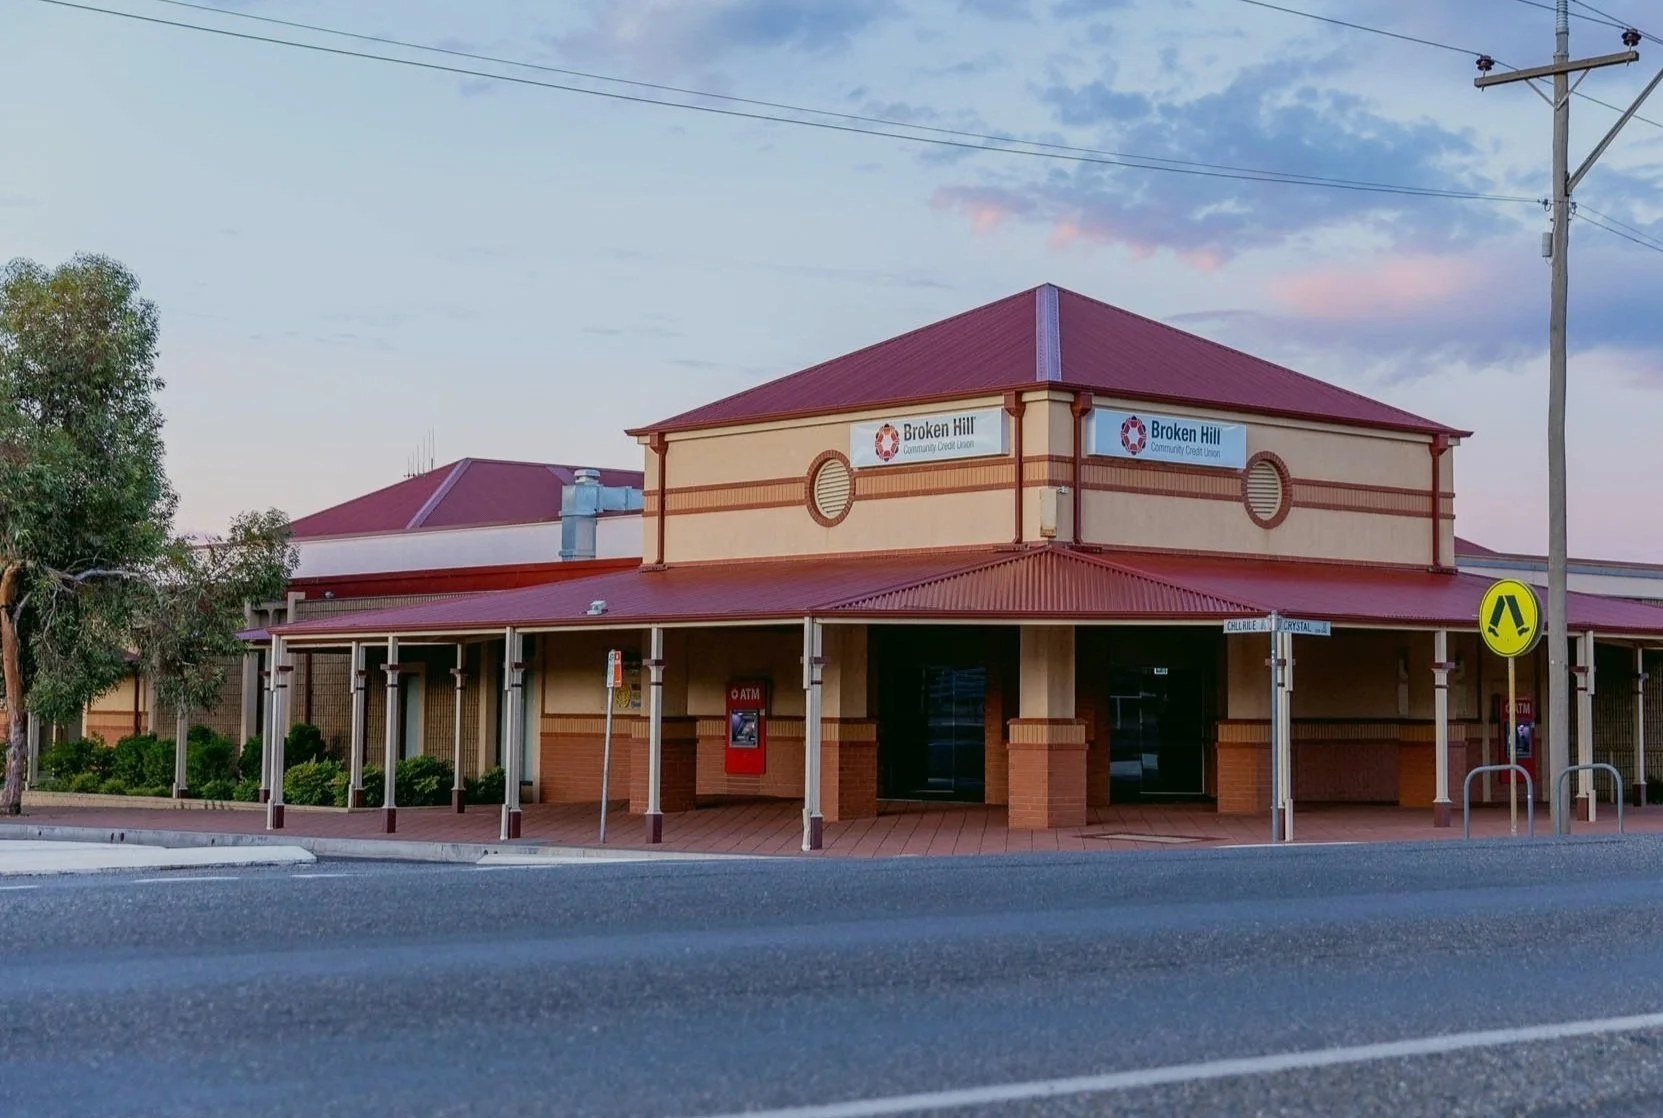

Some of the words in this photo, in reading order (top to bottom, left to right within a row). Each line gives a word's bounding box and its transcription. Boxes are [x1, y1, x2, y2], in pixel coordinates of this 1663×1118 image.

[904, 421, 949, 441] Broken
[953, 416, 974, 436] Hill
[1151, 420, 1196, 442] Broken
[1201, 424, 1220, 445] Hill
[903, 442, 936, 455] Community
[938, 440, 955, 452] Credit
[957, 439, 974, 449] Union
[1151, 442, 1184, 455] Community
[1186, 445, 1203, 457] Credit
[1203, 448, 1220, 458] Union
[1284, 621, 1312, 632] CRYSTAL
[740, 688, 760, 700] ATM
